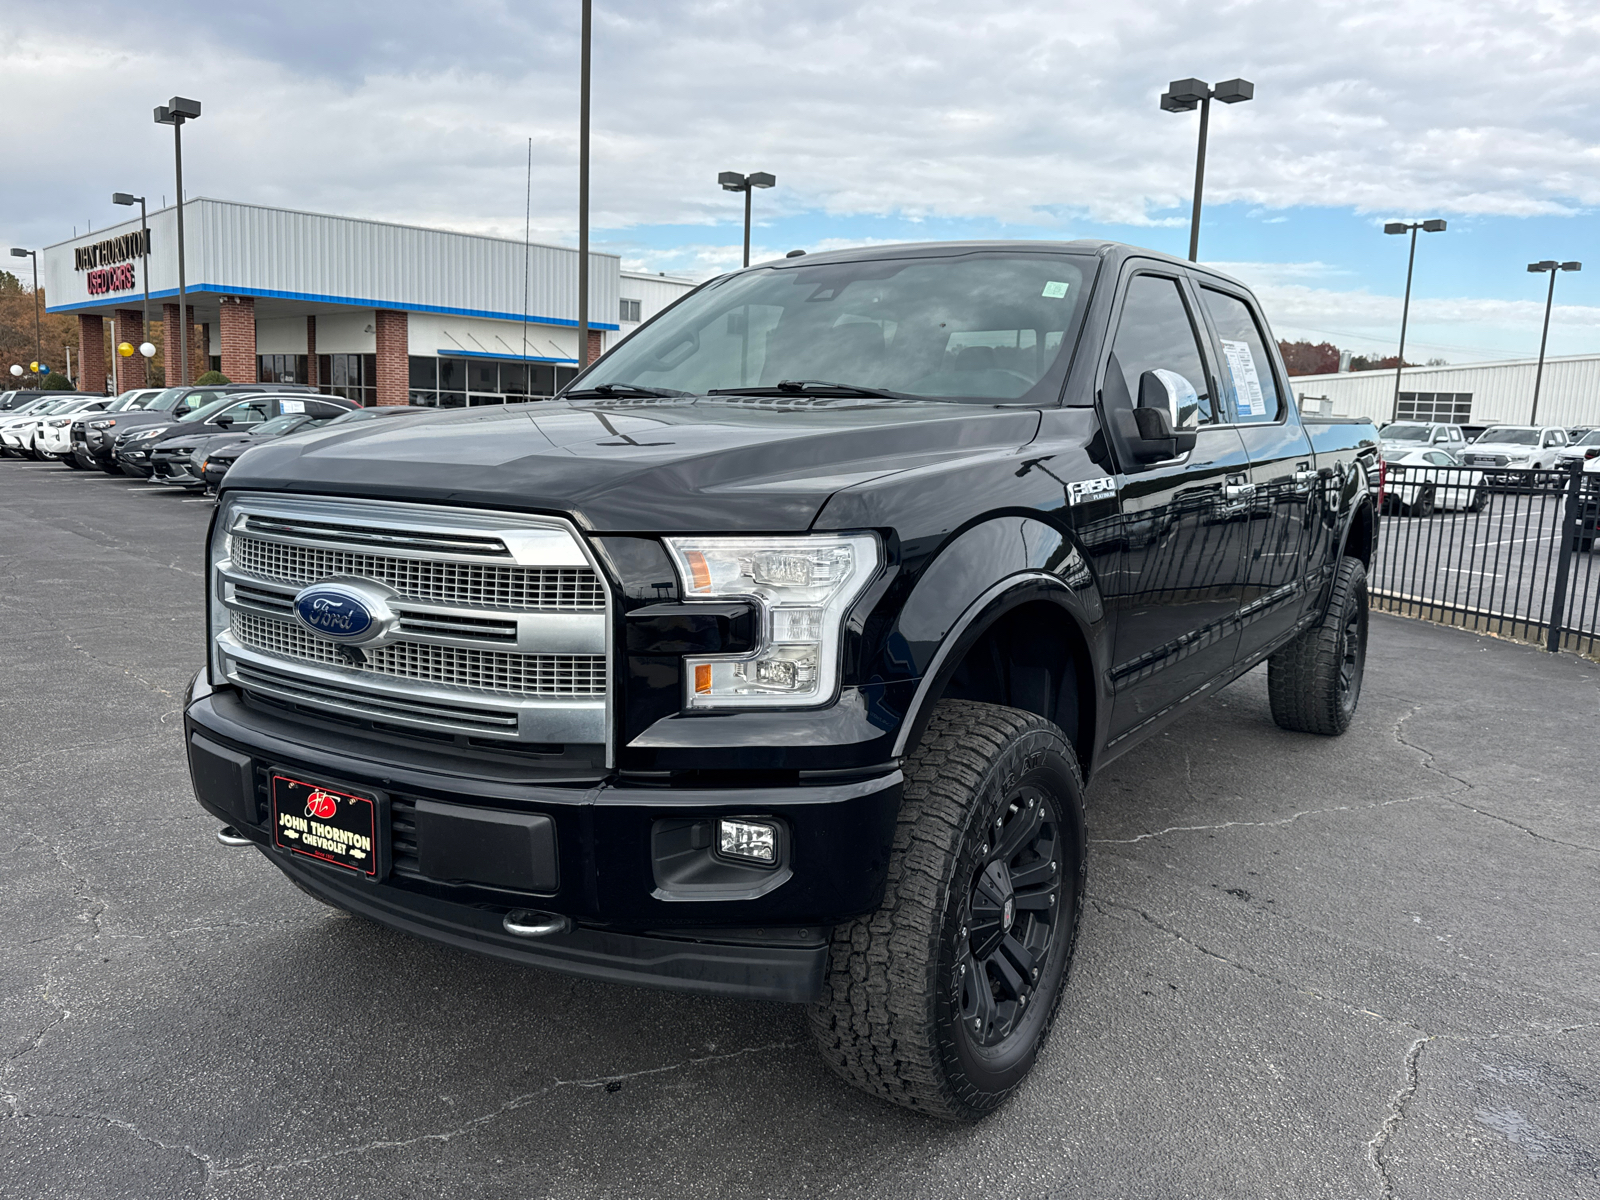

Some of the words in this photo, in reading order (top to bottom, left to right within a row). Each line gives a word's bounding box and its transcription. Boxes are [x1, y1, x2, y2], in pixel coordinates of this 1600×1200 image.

[74, 245, 97, 271] JOHN
[87, 269, 108, 295] USED
[108, 263, 135, 291] CARS
[1093, 491, 1116, 500] PLATINUM
[308, 598, 354, 630] Ford
[279, 812, 308, 833] JOHN
[310, 821, 371, 852] THORNTON
[302, 833, 347, 855] CHEVROLET
